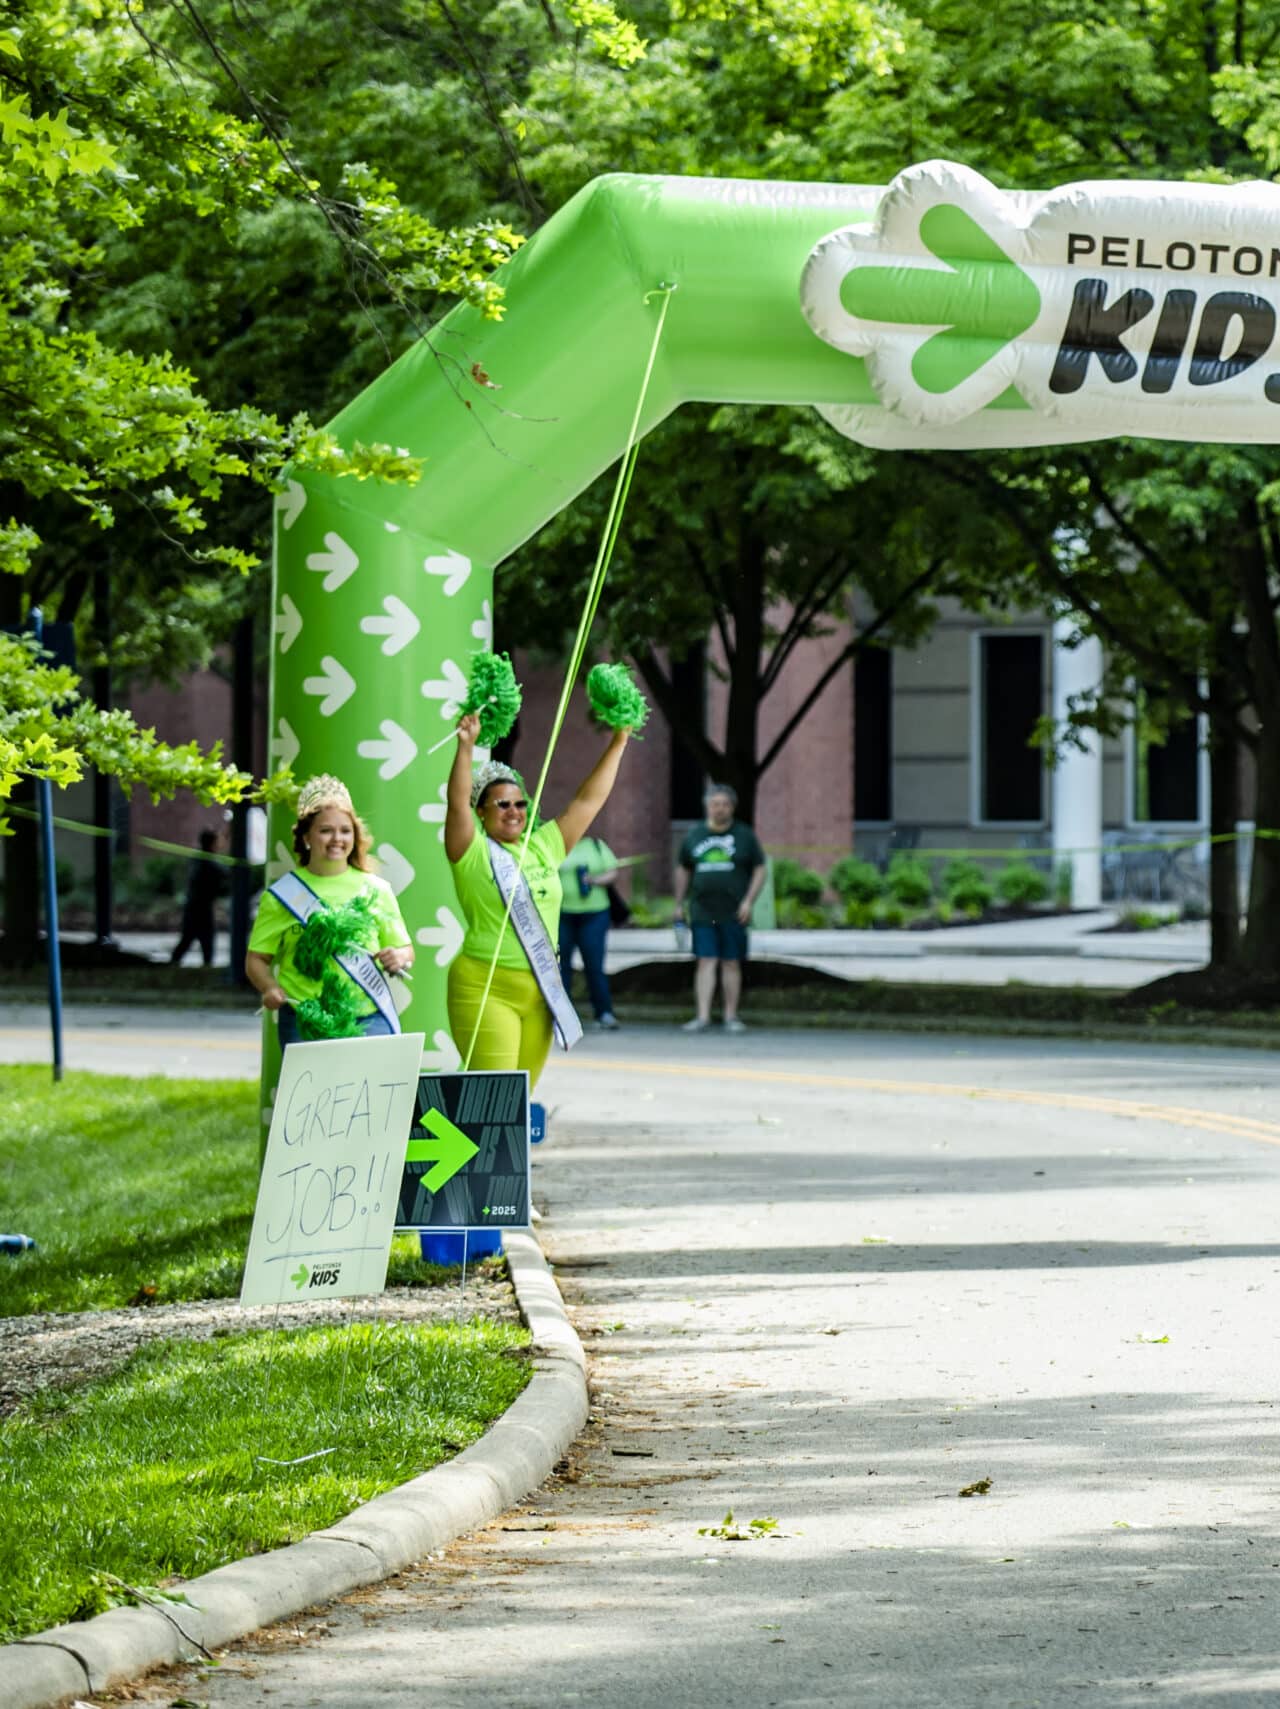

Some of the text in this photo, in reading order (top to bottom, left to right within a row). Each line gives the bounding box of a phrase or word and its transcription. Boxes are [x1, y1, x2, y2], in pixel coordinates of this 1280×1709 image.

[530, 938, 554, 976] World
[358, 961, 385, 997] OHIO
[283, 1070, 409, 1147] GREAT
[491, 1205, 517, 1216] 2025
[309, 1269, 340, 1289] KIDS
